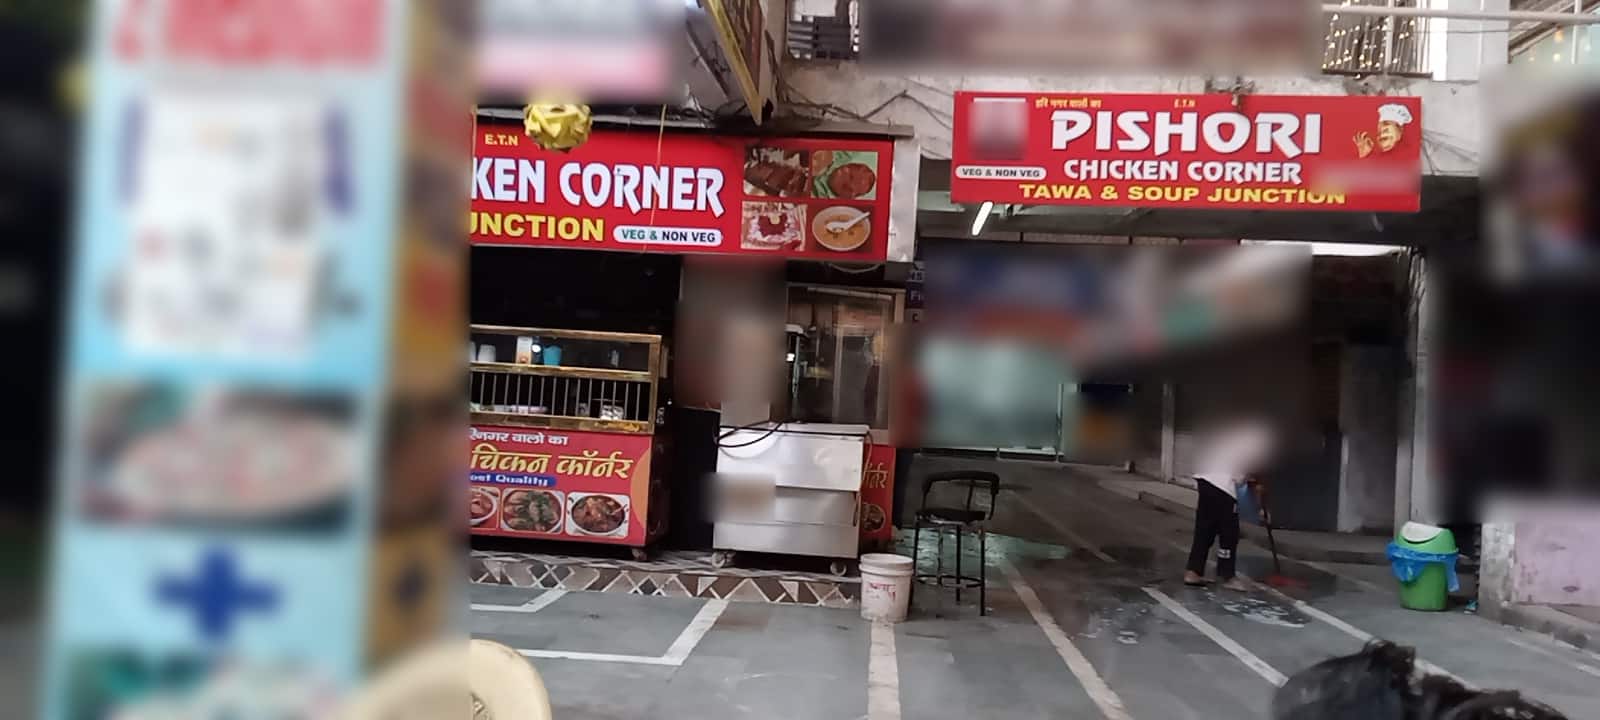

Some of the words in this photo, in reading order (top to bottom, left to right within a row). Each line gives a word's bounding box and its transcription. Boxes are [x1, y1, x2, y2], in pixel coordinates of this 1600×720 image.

[485, 134, 519, 146] E.T.N
[1051, 110, 1322, 158] PISHORI
[962, 168, 982, 177] VEG
[995, 169, 1017, 178] NON
[1020, 169, 1041, 178] VEG
[1063, 159, 1179, 181] CHICKEN
[1187, 161, 1302, 185] CORNER
[559, 162, 725, 218] CORNER
[1019, 183, 1092, 200] TAWA
[1100, 186, 1119, 200] &
[1127, 186, 1200, 202] SOUP
[1207, 187, 1346, 205] JUNCTION
[622, 229, 646, 240] VEG
[649, 230, 658, 241] &
[662, 231, 688, 242] NON
[691, 233, 716, 243] VEG
[495, 474, 549, 487] Quality
